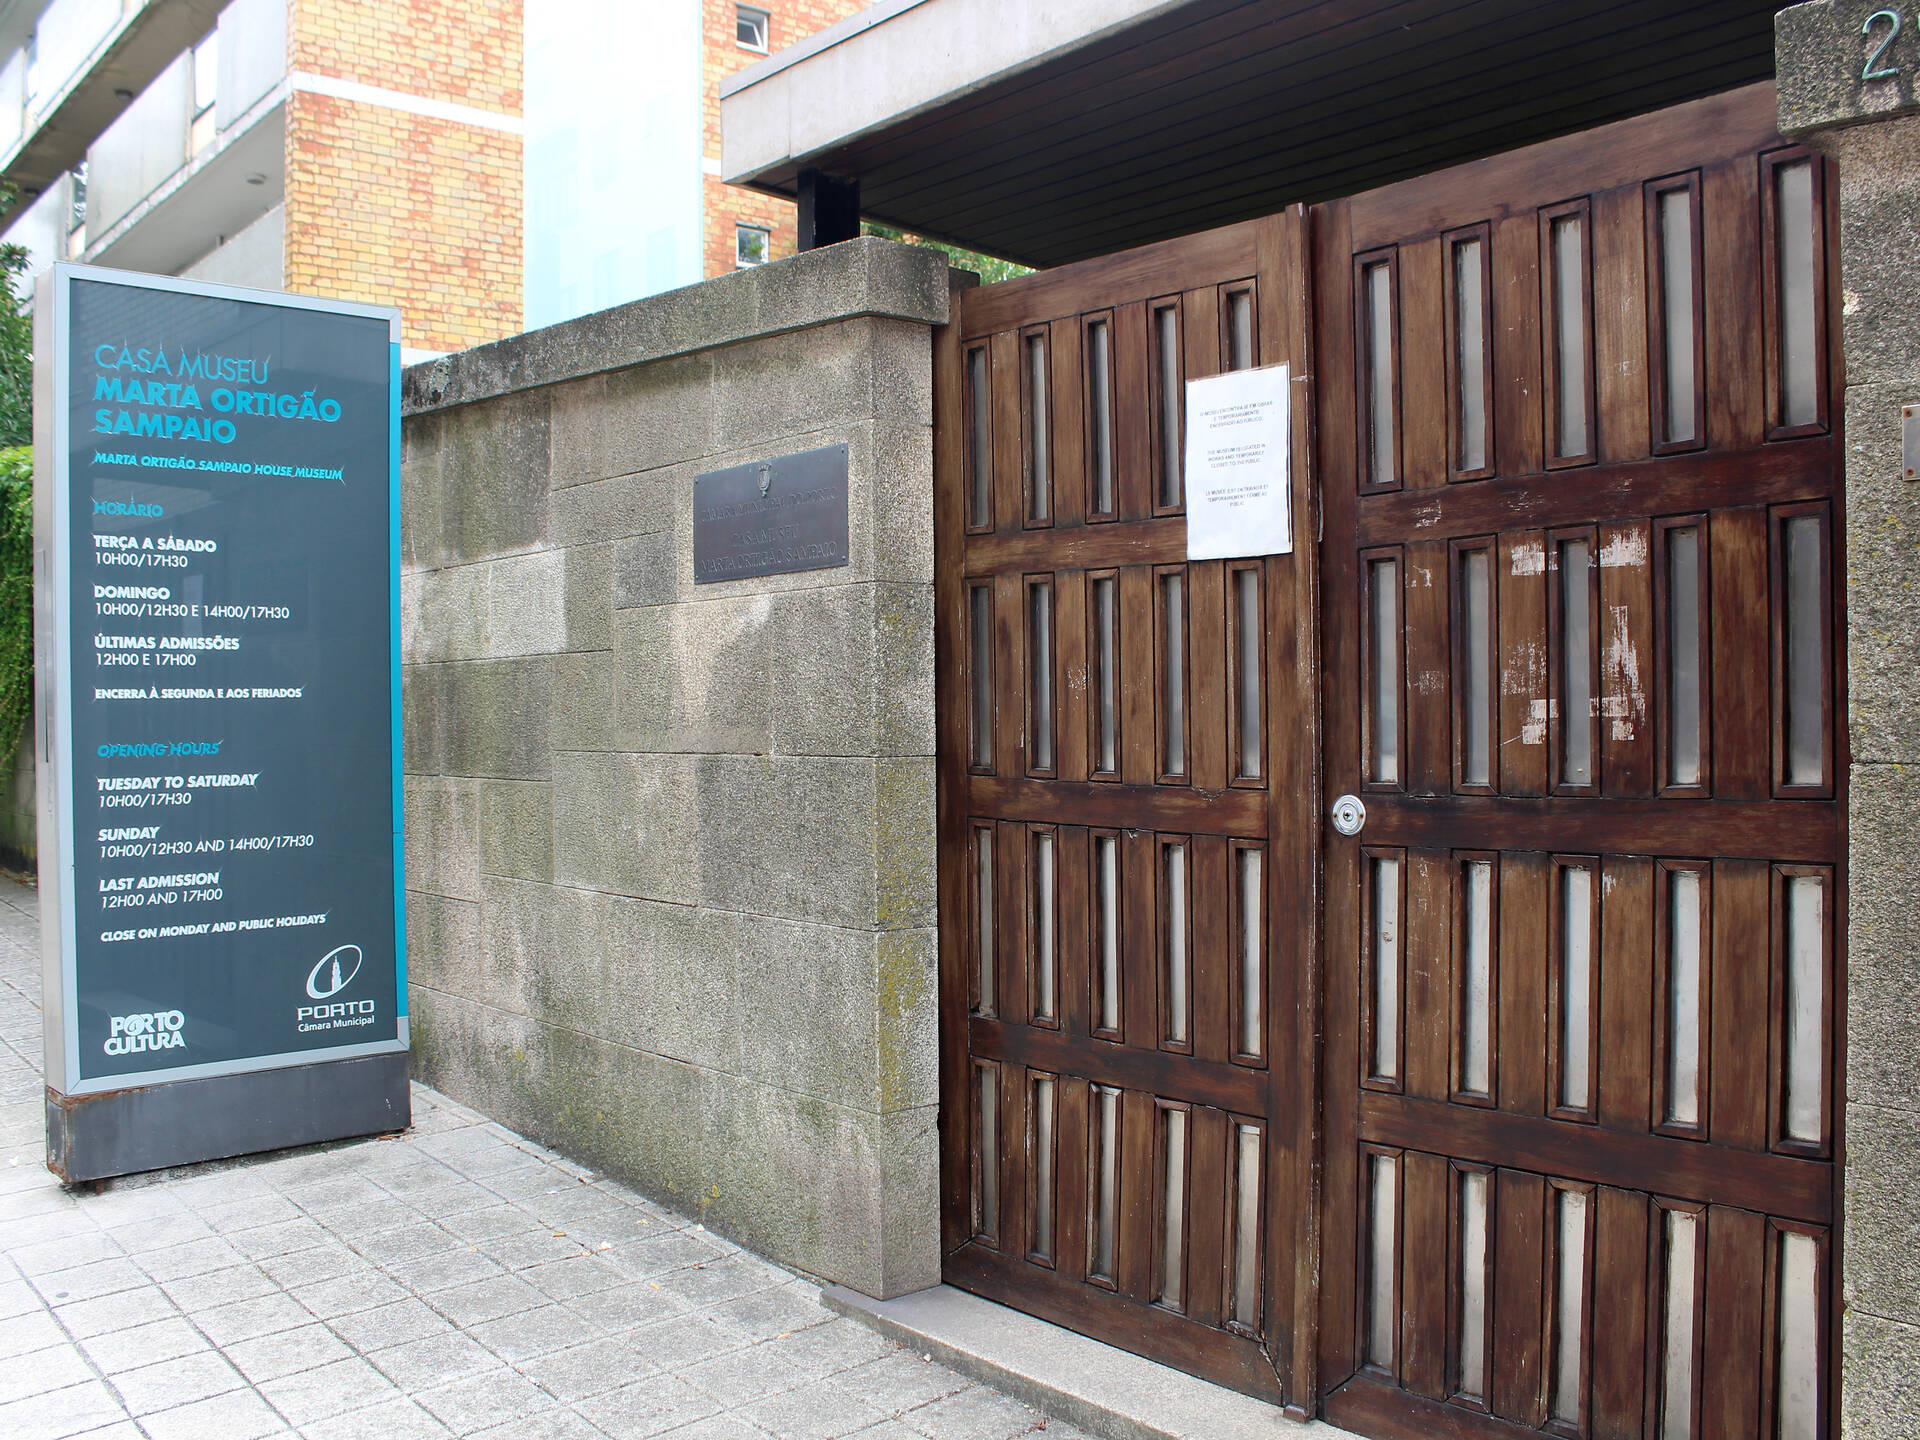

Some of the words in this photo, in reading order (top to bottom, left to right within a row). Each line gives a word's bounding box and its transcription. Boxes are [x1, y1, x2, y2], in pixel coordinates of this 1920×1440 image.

[94, 345, 172, 376] CASA
[179, 353, 269, 384] MUSEU
[94, 377, 202, 410] MARTA
[211, 387, 341, 422] ORTIGÃO
[94, 409, 236, 444] SAMPAIO
[94, 453, 138, 467] MARTA
[141, 456, 196, 470] ORTIGÃO
[199, 460, 252, 474] SAMPAIO
[254, 464, 292, 477] HOUSE
[295, 466, 343, 480] MUSEUM
[94, 501, 164, 518] HORÁRIO
[94, 534, 139, 552] TERÇA
[142, 537, 154, 551] A
[157, 535, 217, 553] SÁBADO
[95, 552, 188, 568] 10H00/17H30
[94, 585, 171, 600] DOMINGO
[96, 602, 188, 618] 10H00/12H30
[191, 604, 199, 617] E
[203, 604, 290, 619] 14H00/17H30
[94, 634, 156, 650] ÚLTIMAS
[160, 635, 240, 651] ADMISSÕES
[96, 653, 139, 666] 12H00
[142, 654, 150, 666] E
[154, 653, 197, 667] 17H00
[95, 688, 147, 700] ENCERRA
[149, 686, 160, 699] À
[161, 688, 215, 699] SEGUNDA
[217, 688, 224, 699] E
[226, 688, 250, 699] AOS
[252, 688, 302, 699] FERIADOS
[97, 743, 166, 758] OPENING
[169, 742, 220, 756] HOURS
[98, 776, 161, 791] TUESDAY
[165, 776, 184, 789] TO
[188, 774, 260, 788] SATURDAY
[100, 792, 192, 808] 10H00/17H30
[98, 826, 160, 842] SUNDAY
[101, 841, 192, 858] 10H00/12H30
[195, 840, 225, 853] AND
[229, 834, 314, 851] 14H00/17H30
[100, 878, 134, 892] LAST
[137, 872, 219, 889] ADMISSION
[102, 894, 144, 909] 12H00
[147, 892, 177, 906] AND
[182, 888, 223, 903] 17H00
[101, 929, 136, 942] CLOSE
[138, 928, 157, 939] ON
[159, 923, 210, 937] MONDAY
[211, 921, 236, 934] AND
[239, 918, 274, 931] PUBLIC
[276, 913, 326, 927] HOLIDAYS
[297, 999, 375, 1021] PORTO
[110, 1009, 185, 1037] PORTO
[298, 1020, 332, 1032] Câmara
[333, 1015, 375, 1030] Municipal
[104, 1032, 186, 1056] CULTURA
